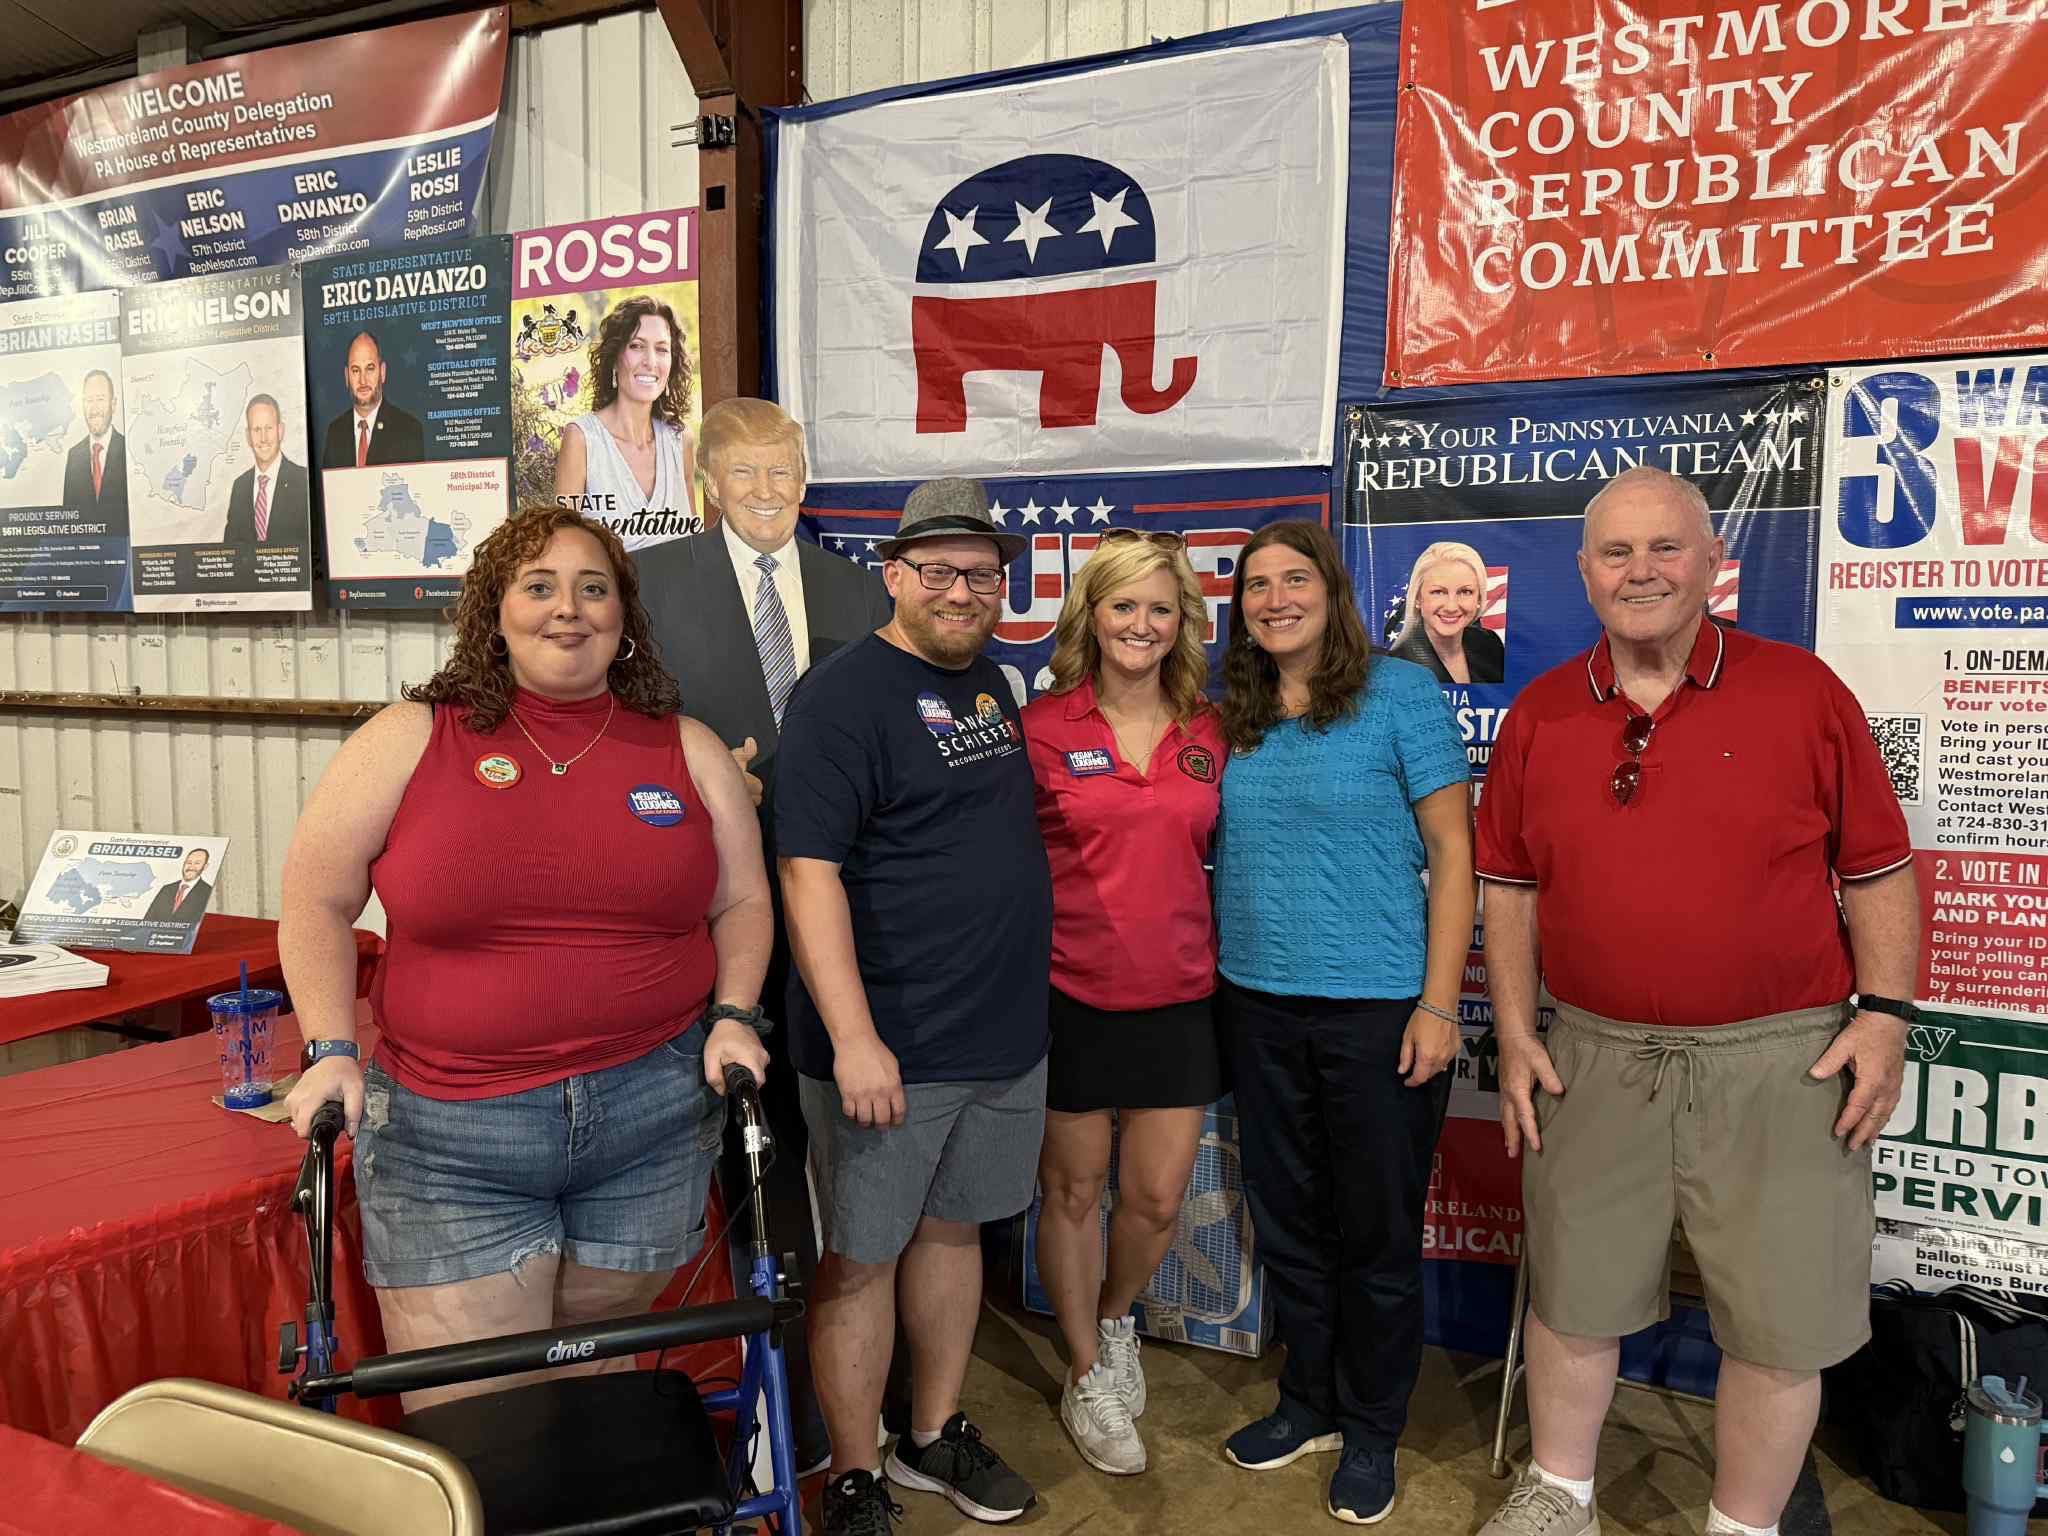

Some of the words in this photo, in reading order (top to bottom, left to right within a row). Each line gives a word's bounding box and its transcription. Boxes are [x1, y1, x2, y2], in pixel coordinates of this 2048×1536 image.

[1478, 0, 2048, 91] WESTMOREL
[123, 71, 245, 121] WELCOME
[75, 119, 169, 158] Westmoreland
[172, 110, 230, 136] County
[234, 92, 333, 124] Delegation
[1479, 71, 1814, 160] COUNTY
[95, 157, 114, 178] PA
[115, 152, 158, 174] House
[161, 146, 177, 164] of
[180, 123, 317, 162] Representatives
[408, 147, 462, 177] LESLIE
[294, 169, 339, 194] ERIC
[1477, 122, 2026, 227] REPUBLICAN
[410, 174, 460, 202] ROSSI
[186, 188, 225, 212] ERIC
[278, 192, 368, 223] DAVANZO
[407, 207, 429, 223] 59th
[431, 199, 464, 218] District
[97, 205, 137, 229] BRIAN
[180, 211, 245, 238] NELSON
[22, 223, 50, 241] JILL
[296, 226, 321, 241] 58th
[323, 222, 358, 238] District
[404, 217, 466, 241] RepRossi.com
[104, 230, 145, 252] RASEL
[192, 242, 212, 257] 57th
[214, 239, 247, 253] District
[288, 237, 370, 260] RepDavanzo.com
[519, 215, 689, 289] ROSSI
[1473, 201, 1995, 294] COMMITTEE
[4, 242, 67, 264] COOPER
[189, 254, 258, 275] RepNelson.com
[332, 262, 365, 280] STATE
[368, 249, 473, 274] REPRESENTATIVE
[321, 277, 372, 309] ERIC
[375, 264, 487, 302] DAVANZO
[128, 306, 184, 336] ERIC
[187, 288, 291, 327] NELSON
[323, 310, 351, 326] 58TH
[353, 301, 427, 322] LEGISLATIVE
[429, 294, 488, 313] DISTRICT
[475, 315, 503, 326] OFFICE
[0, 326, 54, 351] BRIAN
[57, 320, 115, 346] RASEL
[1415, 422, 1497, 450] YOUR
[1509, 412, 1733, 446] PENNSYLVANIA
[1354, 444, 1644, 493] REPUBLICAN
[1660, 436, 1807, 477] TEAM
[1837, 371, 1941, 549] 3
[555, 493, 616, 515] STATE
[8, 511, 44, 522] PROUDLY
[45, 510, 80, 521] SERVING
[23, 525, 70, 536] LEGISLATIVE
[70, 523, 107, 534] DISTRICT
[1829, 560, 1944, 590] REGISTER
[1951, 560, 1981, 588] TO
[1987, 559, 2048, 588] VOTE
[1943, 649, 1959, 671] 1.
[1943, 696, 1993, 712] Your
[2000, 698, 2048, 712] vote
[1940, 719, 1979, 733] Vote
[1984, 720, 2000, 734] in
[1069, 750, 1094, 761] MEGAN
[1940, 735, 1986, 753] Bring
[1992, 739, 2032, 754] your
[1939, 752, 1970, 765] and
[1976, 754, 2013, 767] cast
[630, 791, 662, 801] MEGAN
[1938, 799, 2003, 814] Contact
[1937, 815, 1952, 828] at
[1936, 831, 2000, 846] confirm
[91, 844, 136, 856] BRIAN
[136, 846, 180, 858] RASEL
[1935, 859, 1953, 880] 2.
[1960, 860, 2012, 884] VOTE
[2017, 863, 2040, 885] IN
[1934, 890, 1998, 908] MARK
[159, 921, 191, 930] DISTRICT
[1932, 908, 1980, 923] AND
[1986, 911, 2047, 928] PLAN
[1932, 930, 1979, 948] Bring
[1983, 936, 2023, 950] your
[2028, 936, 2047, 949] ID
[1930, 950, 1970, 961] your
[1976, 951, 2035, 967] polling
[1930, 962, 1979, 976] ballot
[1983, 967, 2013, 981] you
[2018, 970, 2048, 982] can
[1929, 977, 1951, 994] by
[1956, 981, 2048, 998] surrenderi
[1928, 993, 1945, 1006] of
[1951, 996, 2031, 1014] elections
[1878, 1147, 1975, 1177] FIELD
[1916, 1246, 1979, 1267] ballots
[1985, 1259, 2033, 1275] must
[1916, 1263, 2002, 1287] Elections
[546, 1340, 597, 1363] drive
